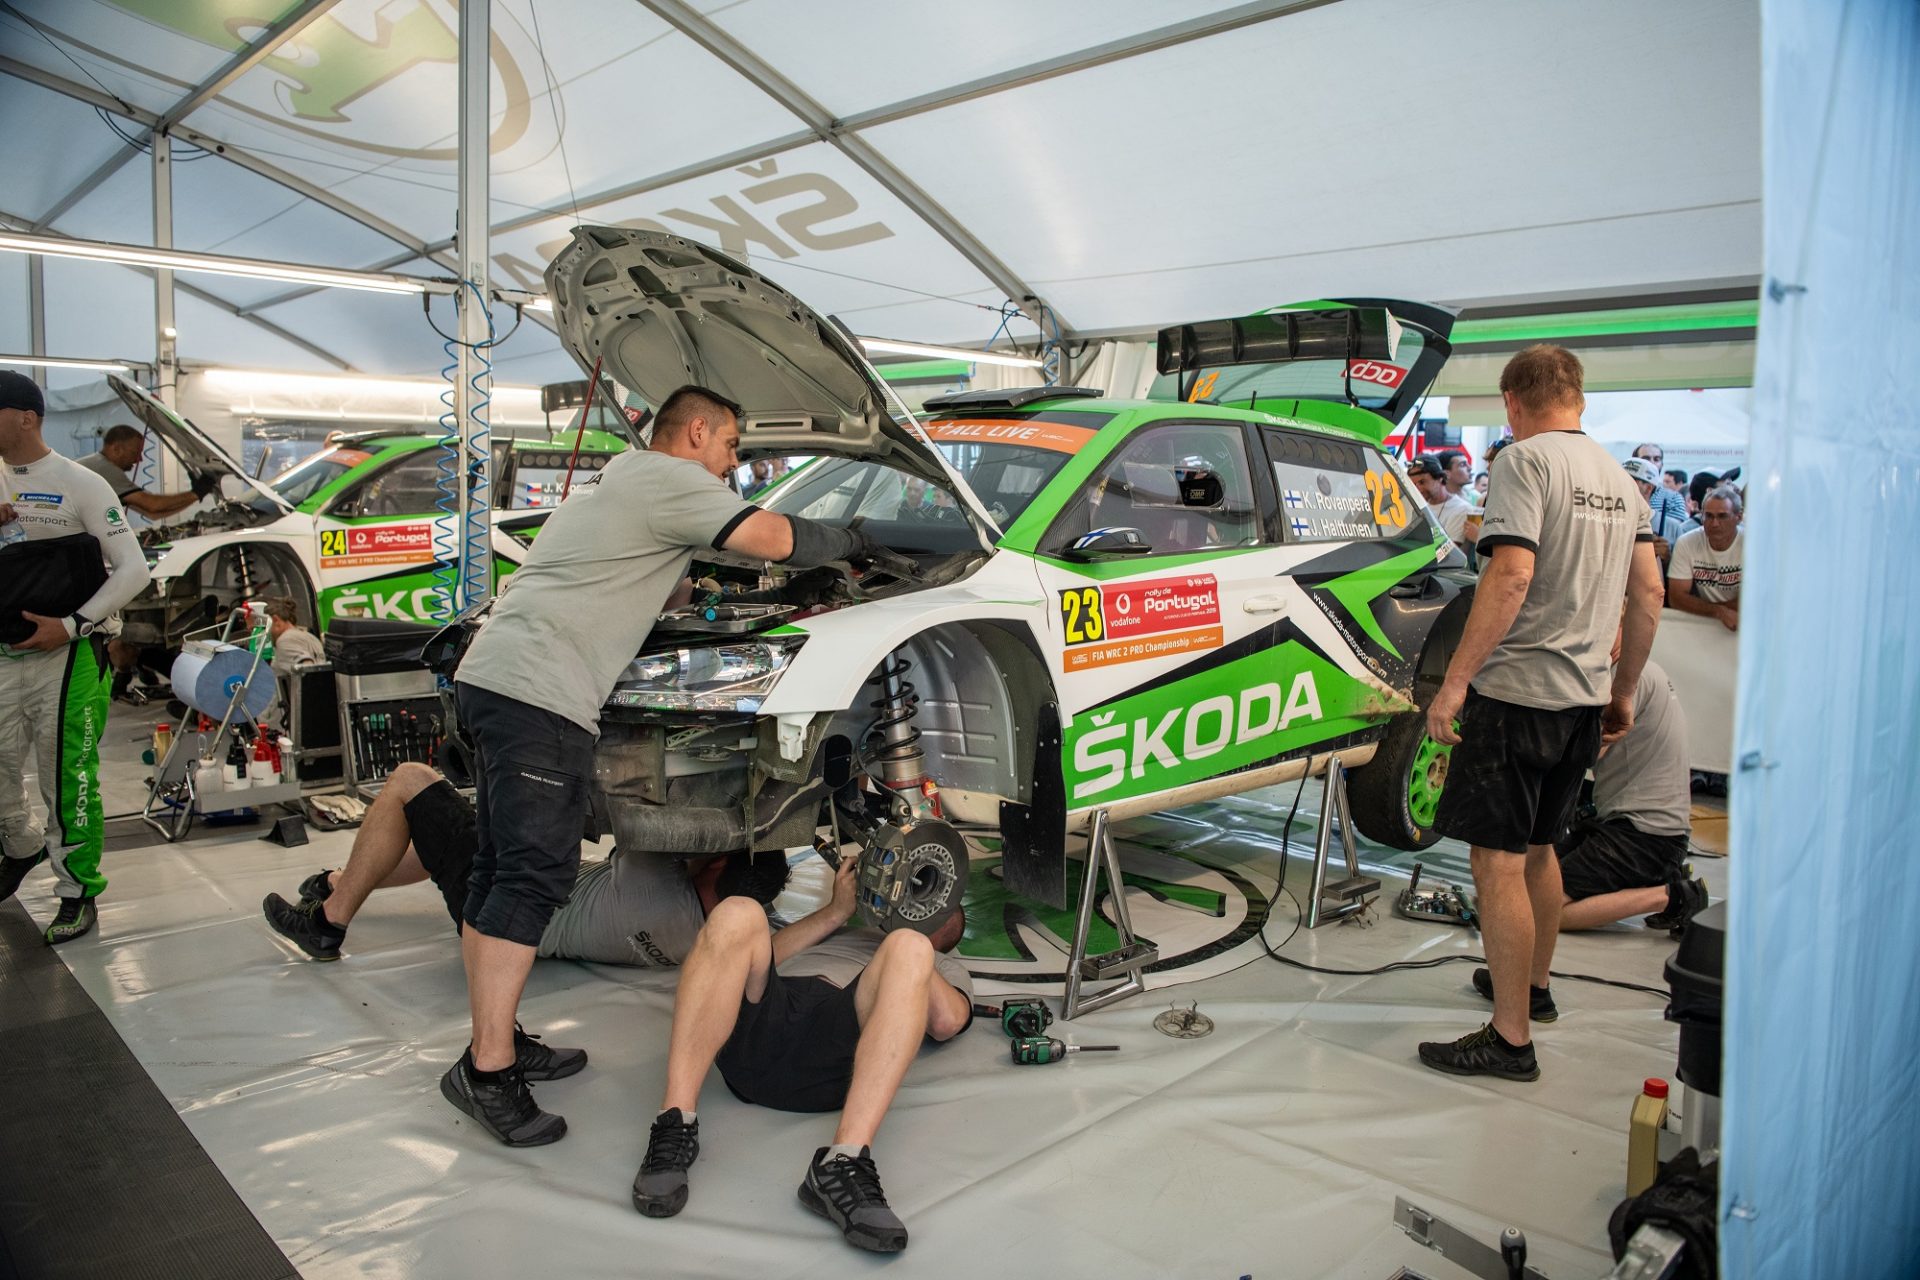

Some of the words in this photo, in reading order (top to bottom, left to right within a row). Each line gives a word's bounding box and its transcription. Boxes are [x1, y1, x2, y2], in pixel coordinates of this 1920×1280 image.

[987, 427, 1039, 440] LIVE
[1302, 491, 1316, 509] K.
[1316, 492, 1371, 515] Rovanperä
[1364, 469, 1407, 528] 23
[1574, 487, 1626, 513] ŠKODA
[375, 533, 430, 544] Portugal
[1311, 519, 1321, 536] J.
[1321, 519, 1372, 537] Halttunen
[322, 530, 346, 556] 24
[332, 588, 464, 621] ŠKO
[1144, 591, 1216, 613] Portugal
[1063, 588, 1103, 643] 23
[1110, 616, 1141, 627] vodafone
[1092, 652, 1105, 661] FIA
[1106, 648, 1122, 659] WRC
[1123, 647, 1128, 656] 2
[1129, 643, 1144, 655] PRO
[1145, 637, 1190, 653] Championship
[1073, 670, 1324, 799] ŠKODA
[74, 770, 89, 827] ŠKODA
